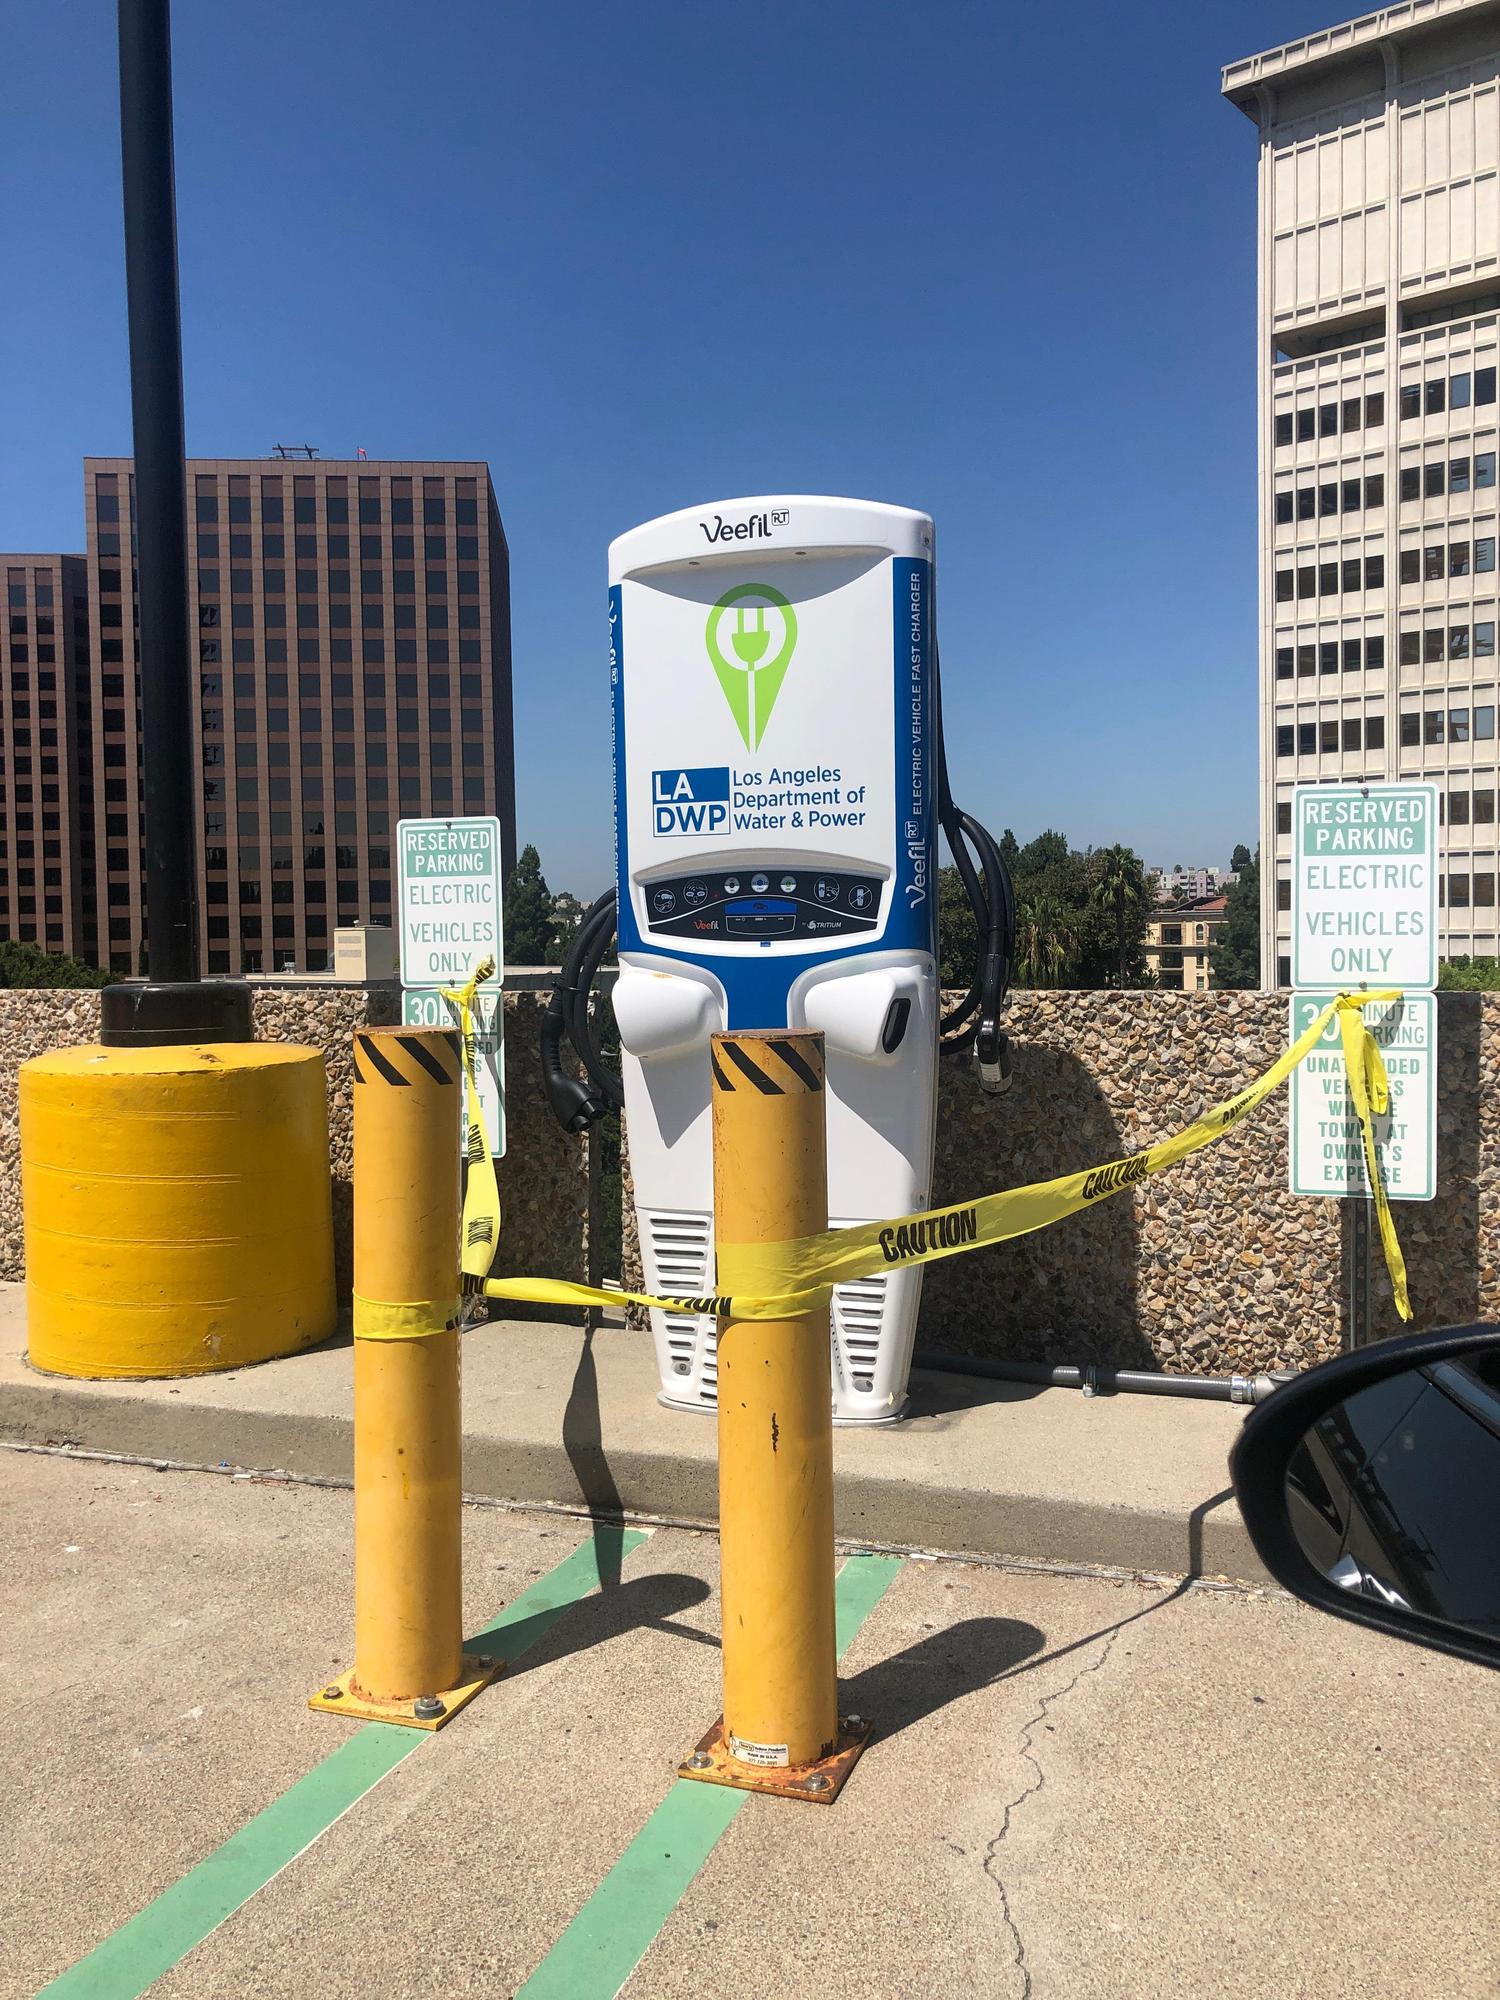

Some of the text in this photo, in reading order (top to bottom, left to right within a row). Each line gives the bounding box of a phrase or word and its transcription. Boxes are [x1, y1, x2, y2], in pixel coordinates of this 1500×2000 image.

[699, 510, 789, 543] Veefil RT
[906, 572, 926, 909] Veefil RT ELECTRIC VEHICLE FAST CHARGER
[655, 772, 694, 801] LA
[733, 766, 841, 787] Los Angeles
[733, 786, 865, 810] Department of
[656, 804, 727, 833] DWP
[733, 810, 866, 830] Water & Power
[1306, 800, 1424, 824] RESERVED
[407, 831, 490, 851] RESERVED
[1316, 827, 1414, 850] PARKING
[415, 853, 484, 873] PARKING
[1307, 864, 1424, 889] ELECTRIC
[410, 883, 492, 905] ELECTRIC
[410, 922, 493, 943] VEHICLES
[693, 920, 719, 930] Veefil
[1306, 911, 1424, 936] VEHICLES
[429, 952, 472, 972] ONLY
[1331, 948, 1393, 972] ONLY
[410, 997, 438, 1026] 30
[442, 1015, 496, 1030] PAKING
[1306, 1057, 1420, 1075] UNADED
[1386, 1123, 1408, 1140] AT
[1324, 1165, 1402, 1184] EXPESE
[879, 1208, 977, 1263] CAUTION
